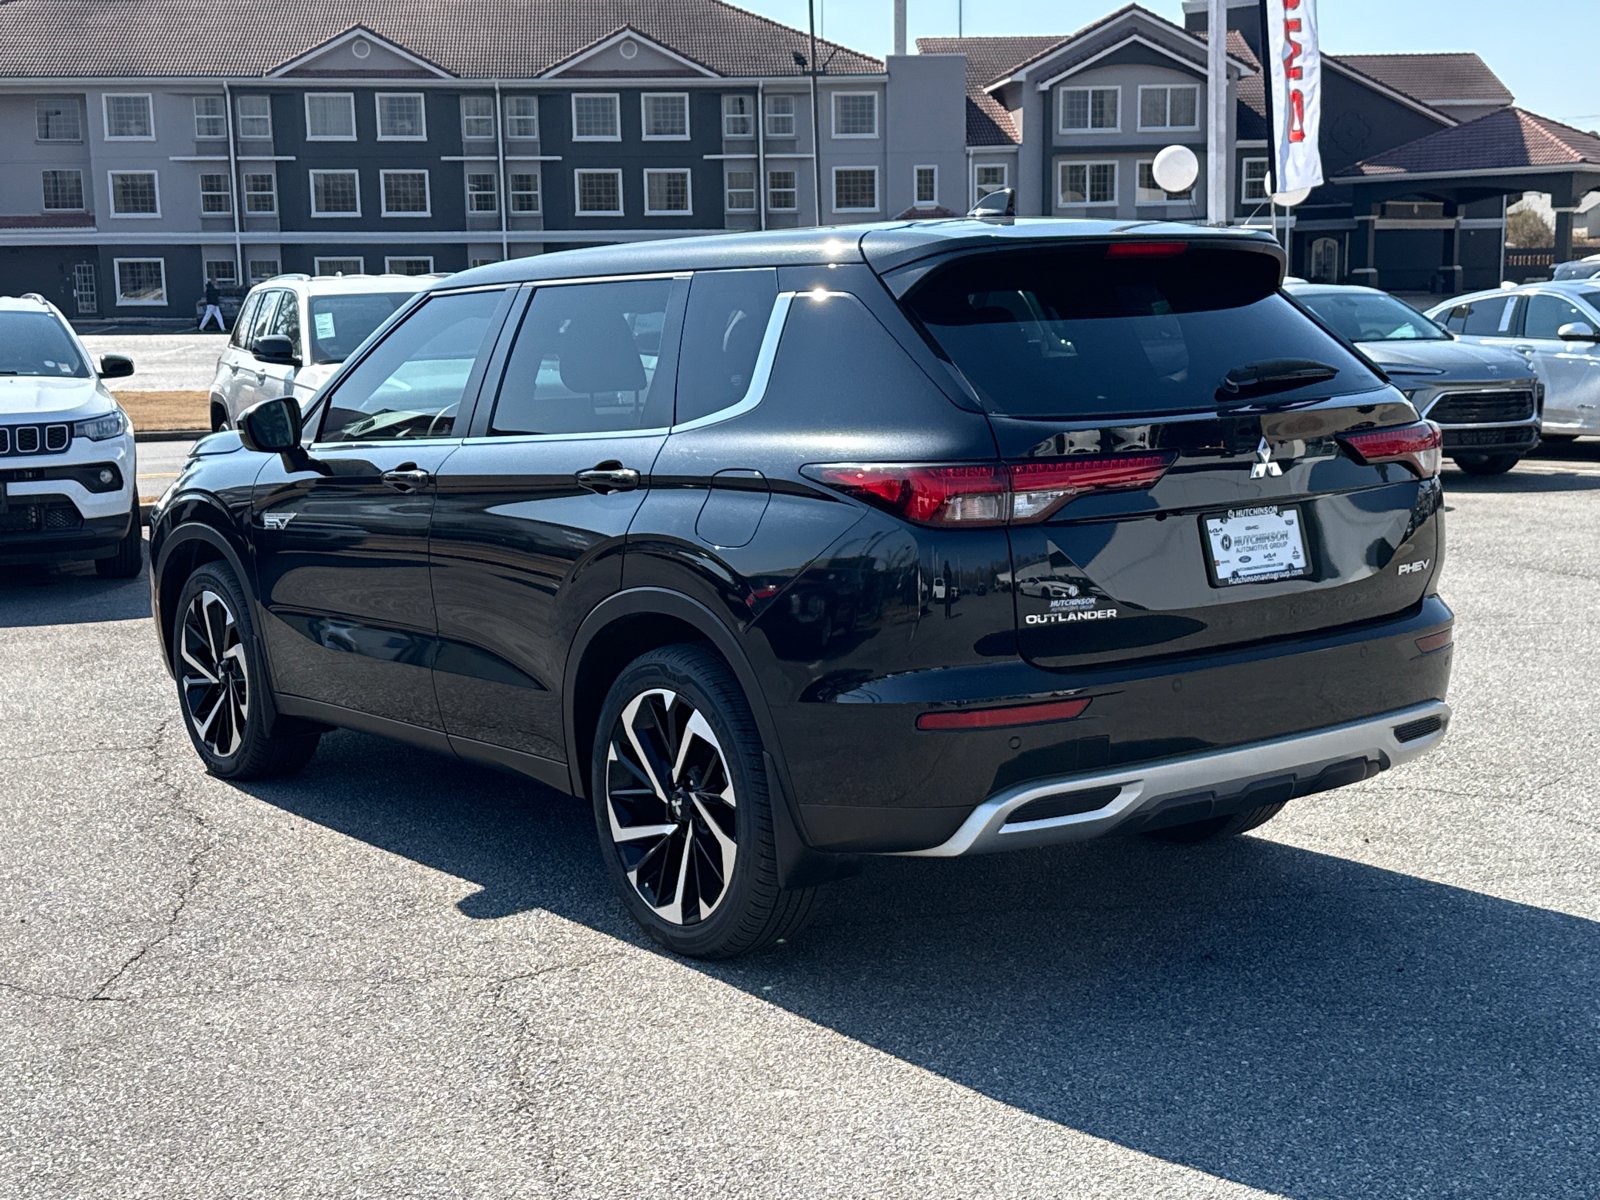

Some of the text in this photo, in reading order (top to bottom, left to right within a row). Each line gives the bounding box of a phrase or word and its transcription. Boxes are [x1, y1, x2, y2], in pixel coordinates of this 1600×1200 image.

[1236, 506, 1278, 517] HUTCHINSON
[1234, 530, 1289, 546] HUTCHINSON
[1236, 541, 1288, 553] AUTOMOTIVE GROUP
[1398, 558, 1430, 575] PHEV
[1050, 598, 1096, 607] HUTCHINSON
[1025, 609, 1117, 624] OUTLANDER
